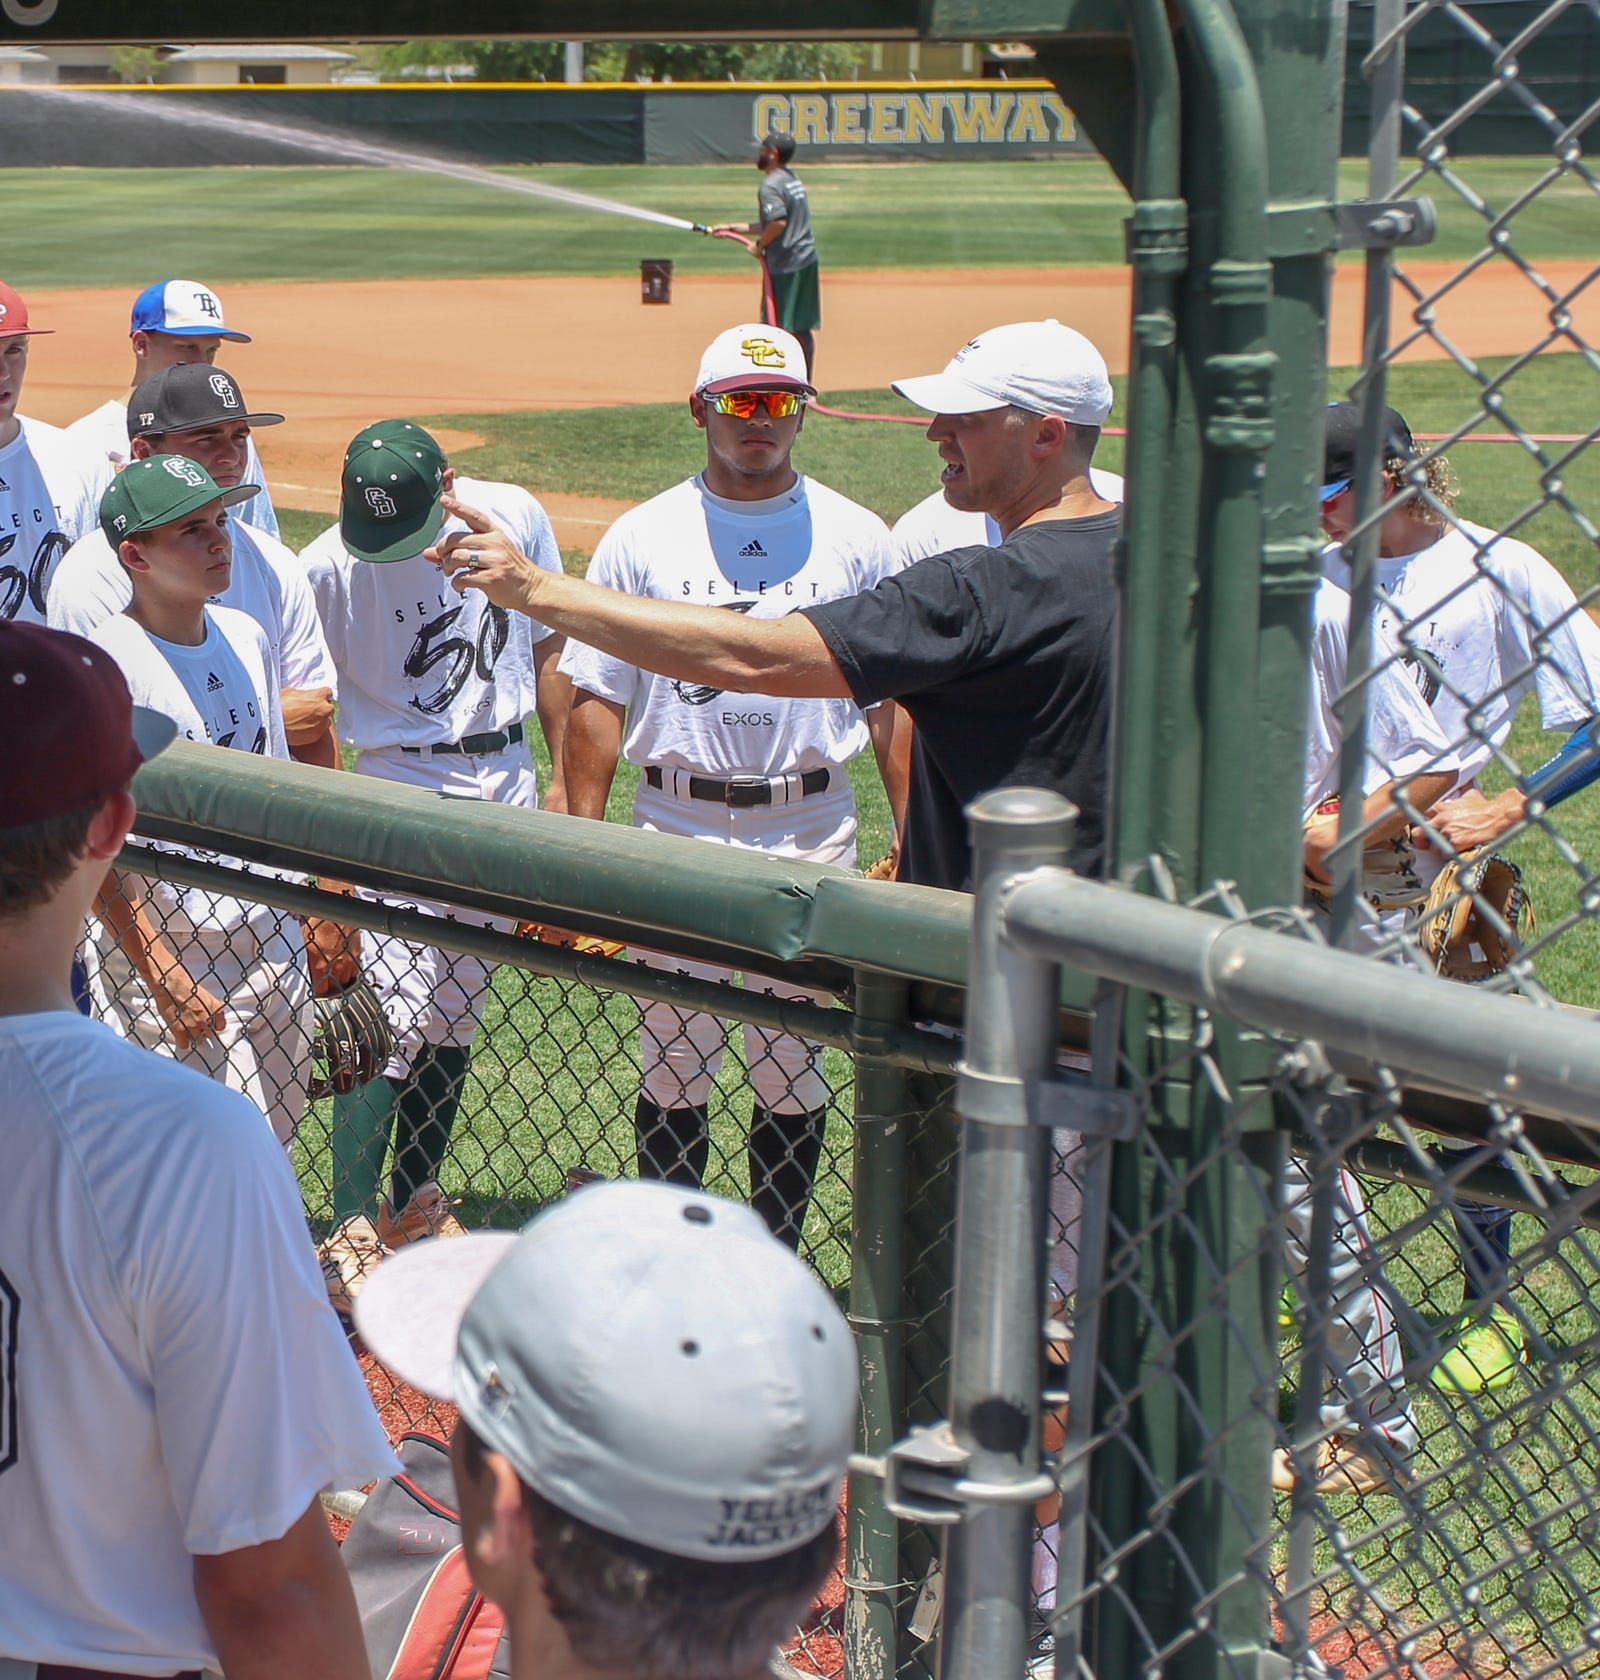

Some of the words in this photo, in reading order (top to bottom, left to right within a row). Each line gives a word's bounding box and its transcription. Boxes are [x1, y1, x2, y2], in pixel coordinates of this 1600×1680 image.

[753, 91, 1078, 144] GREENWAY
[738, 549, 768, 558] adidas
[682, 580, 819, 597] SELECT
[394, 591, 468, 623] SELE
[403, 600, 510, 715] 50
[722, 711, 774, 727] EXOS
